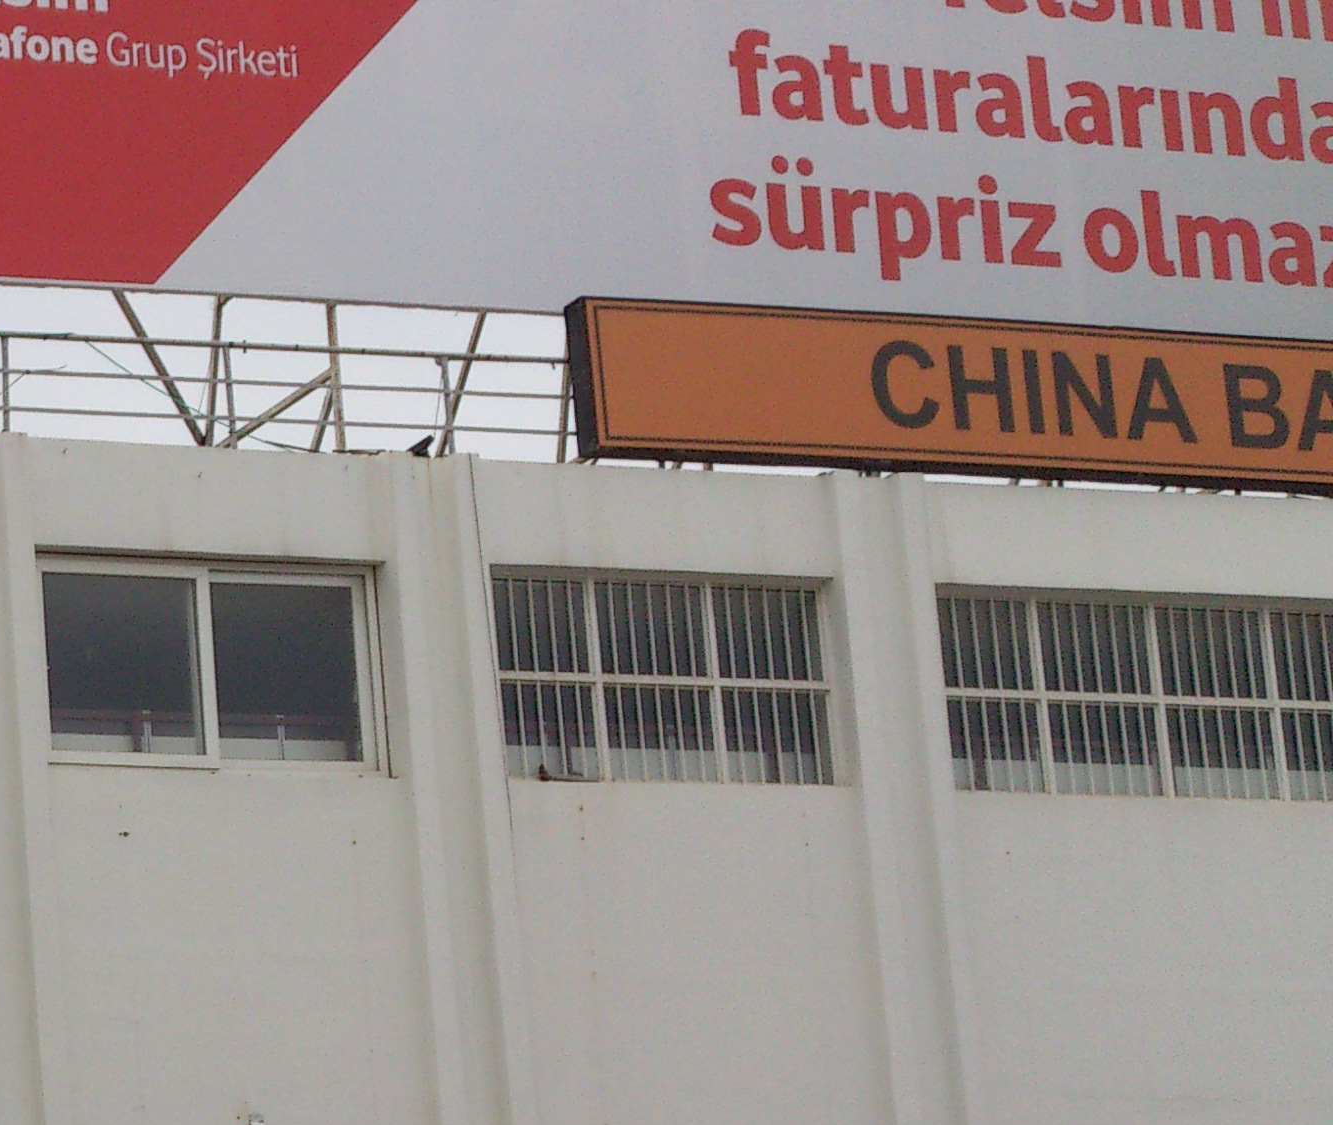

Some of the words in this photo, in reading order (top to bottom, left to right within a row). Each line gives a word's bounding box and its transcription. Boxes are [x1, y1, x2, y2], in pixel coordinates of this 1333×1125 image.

[106, 31, 187, 79] Grup
[196, 37, 300, 80] Şirketi
[709, 155, 1062, 282] sürpriz
[1083, 189, 1333, 289] olma
[870, 340, 1198, 444] CHINA
